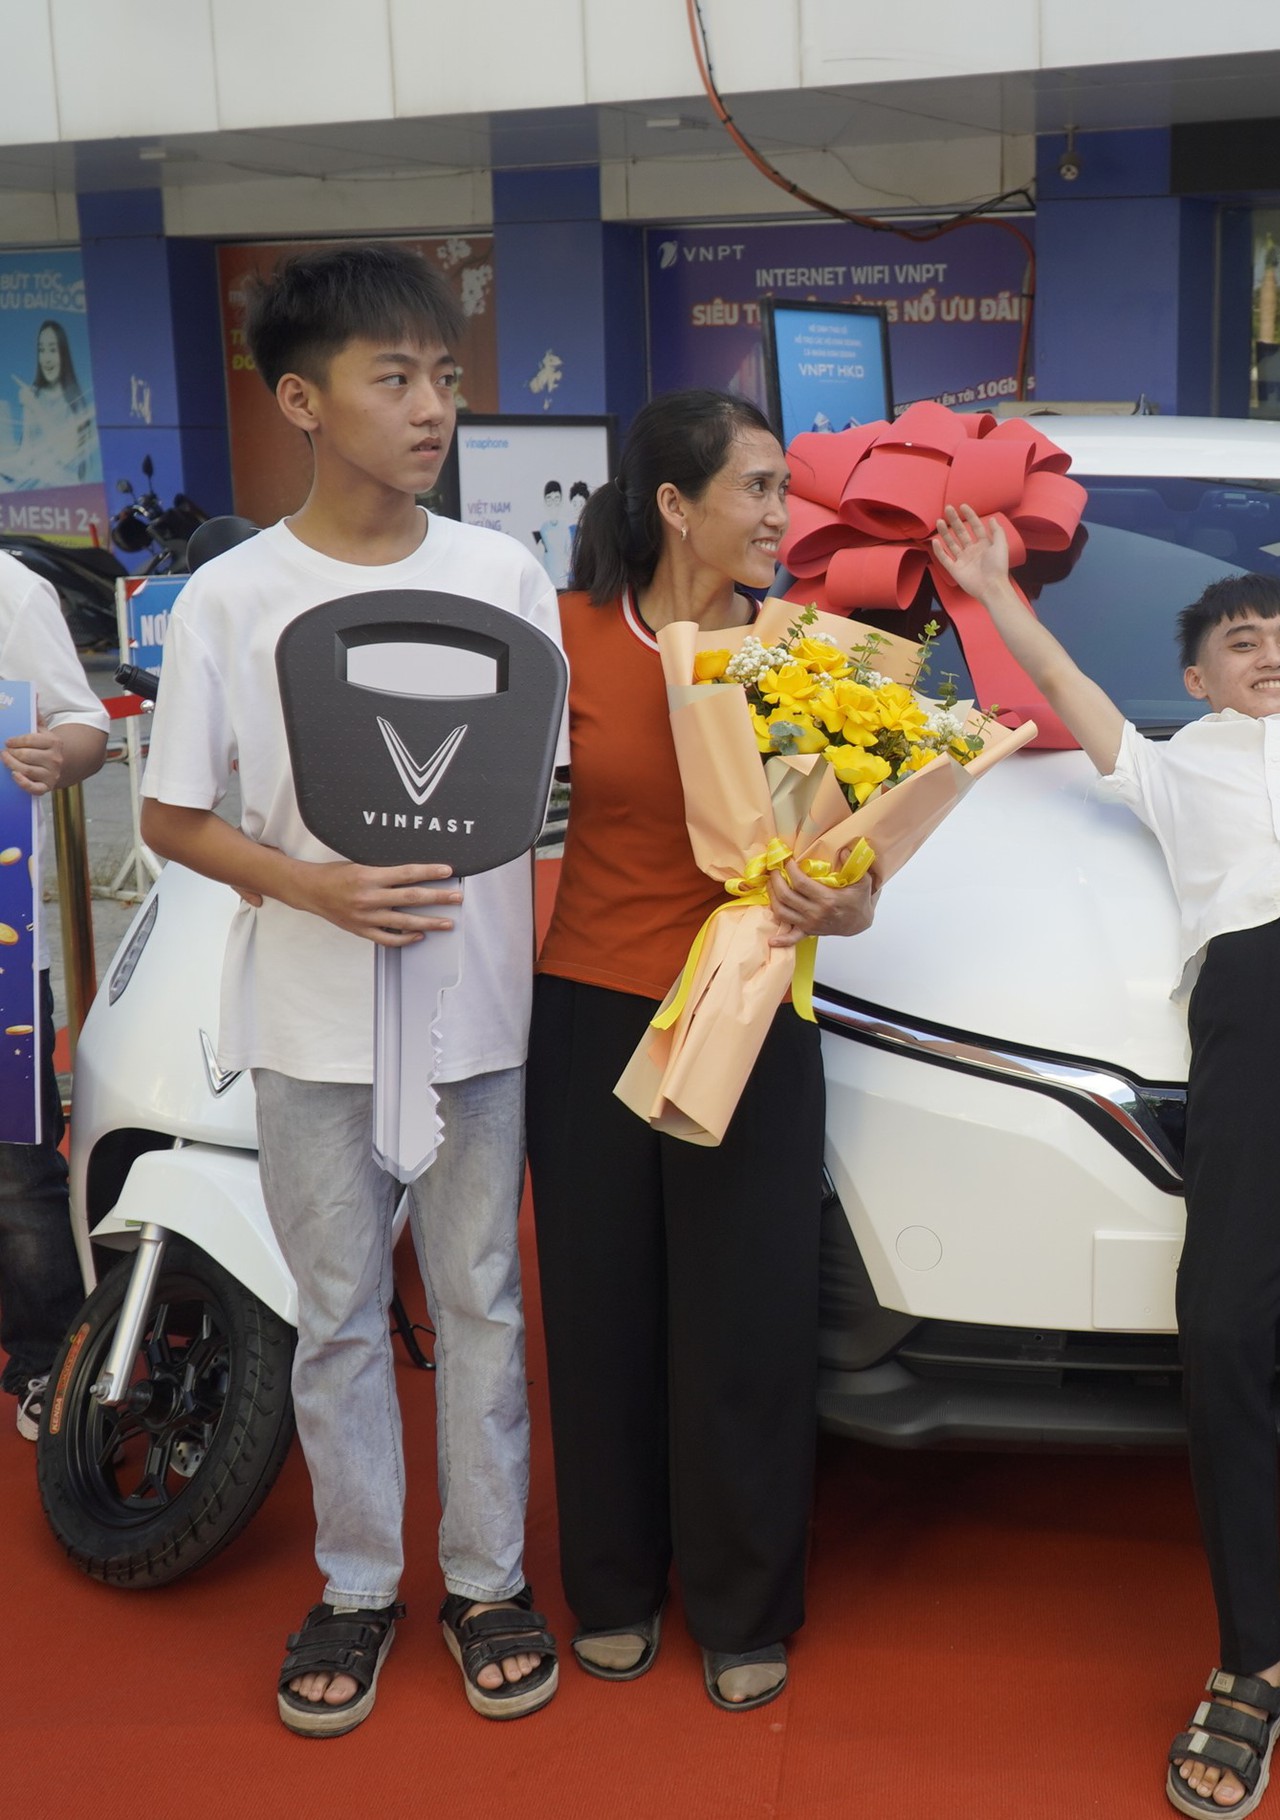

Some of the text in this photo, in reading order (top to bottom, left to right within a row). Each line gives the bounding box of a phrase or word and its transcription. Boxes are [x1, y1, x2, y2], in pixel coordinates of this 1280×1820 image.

[683, 245, 745, 262] VNPT
[755, 263, 948, 287] INTERNET WIFI VNPT
[692, 298, 739, 326] SIÊU
[903, 287, 936, 323] NỔ
[940, 296, 976, 322] ƯU
[979, 290, 1020, 322] ĐÃI
[798, 363, 835, 377] VNPT
[976, 377, 1036, 399] 10Gbs
[465, 437, 509, 450] vinaphone
[9, 505, 71, 531] MESH
[467, 500, 511, 514] VIỆT NAM
[363, 811, 475, 834] VINFAST
[51, 1398, 63, 1430] KENDA
